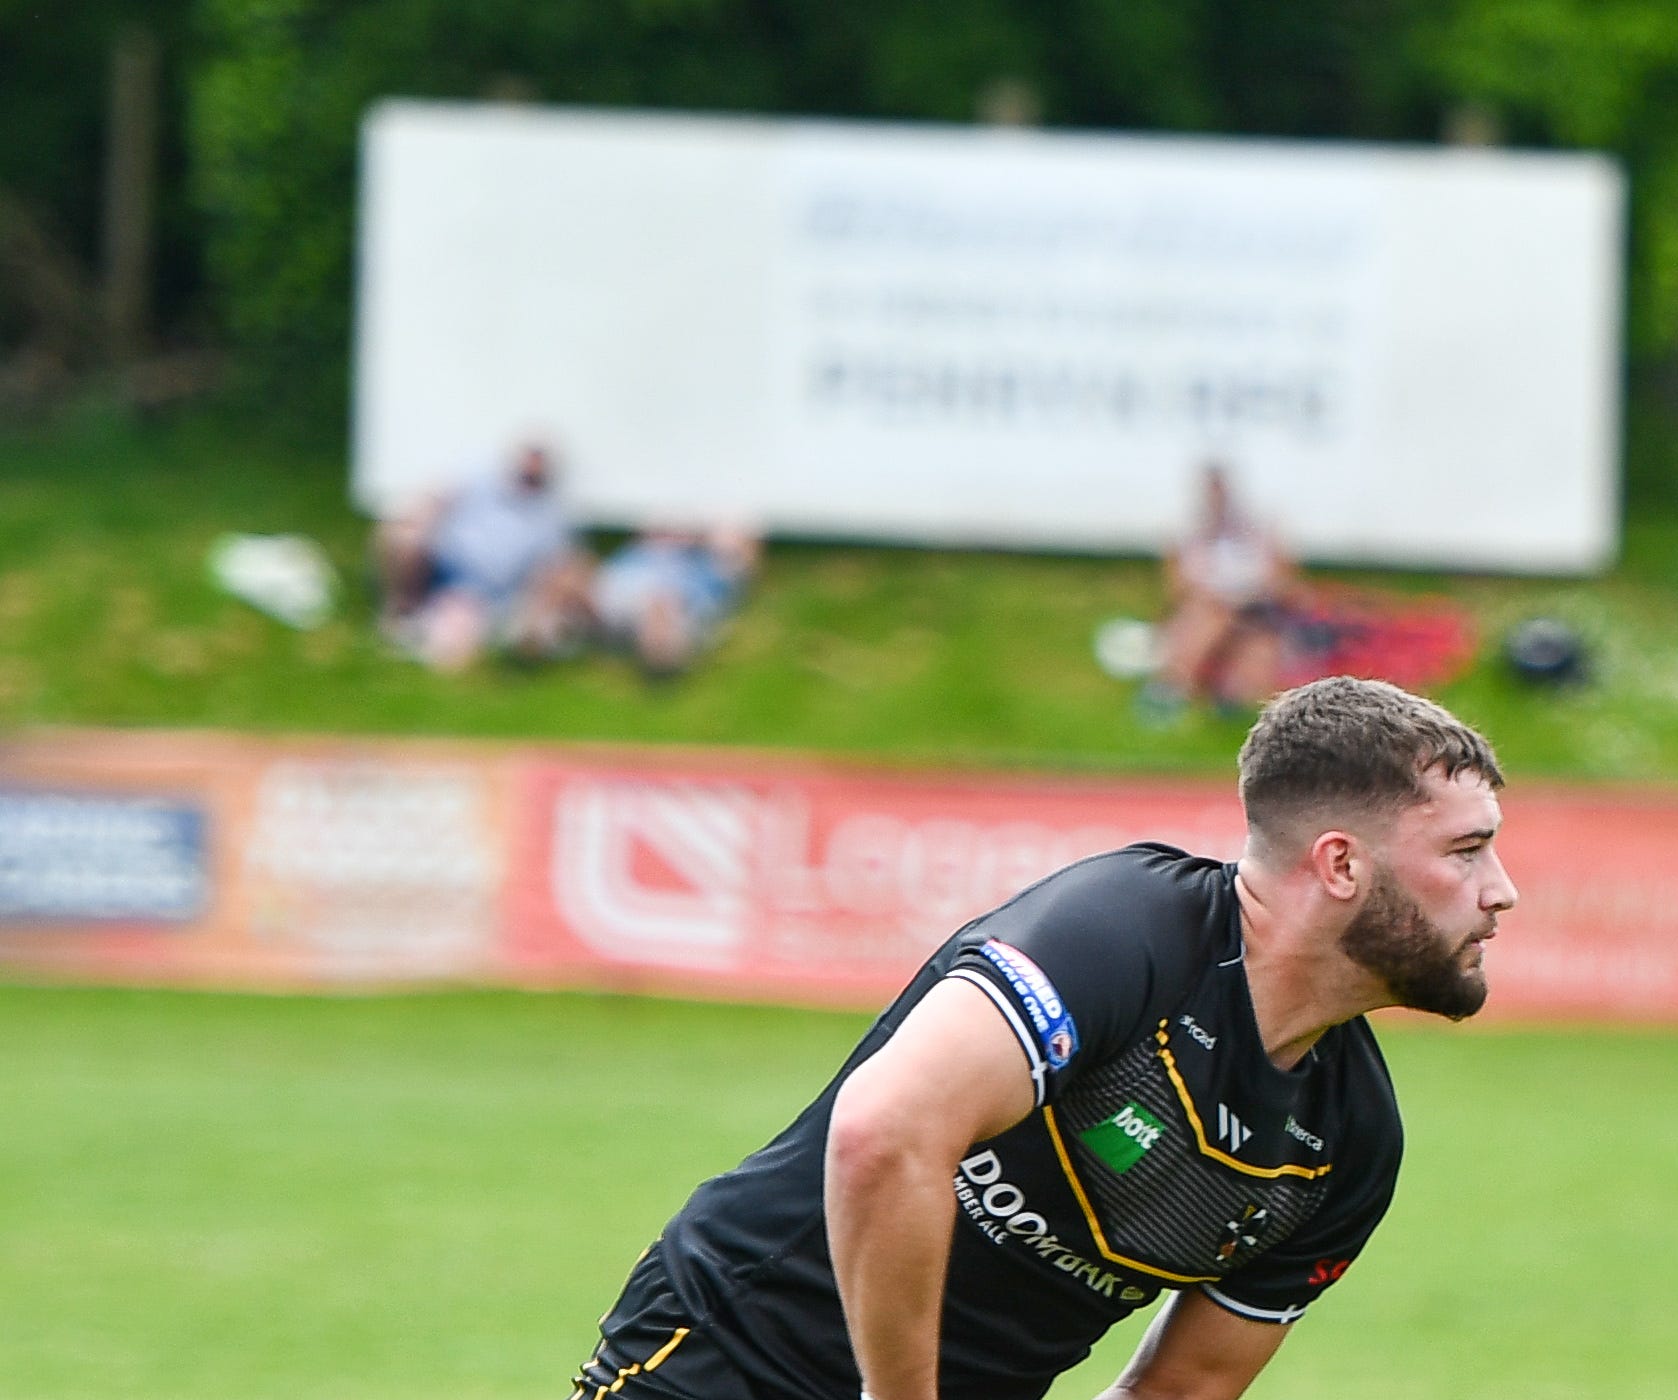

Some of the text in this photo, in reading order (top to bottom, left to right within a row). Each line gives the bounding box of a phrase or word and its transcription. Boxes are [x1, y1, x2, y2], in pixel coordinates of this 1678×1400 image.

[1112, 1106, 1159, 1150] bott
[953, 1174, 1008, 1245] MBER ALE
